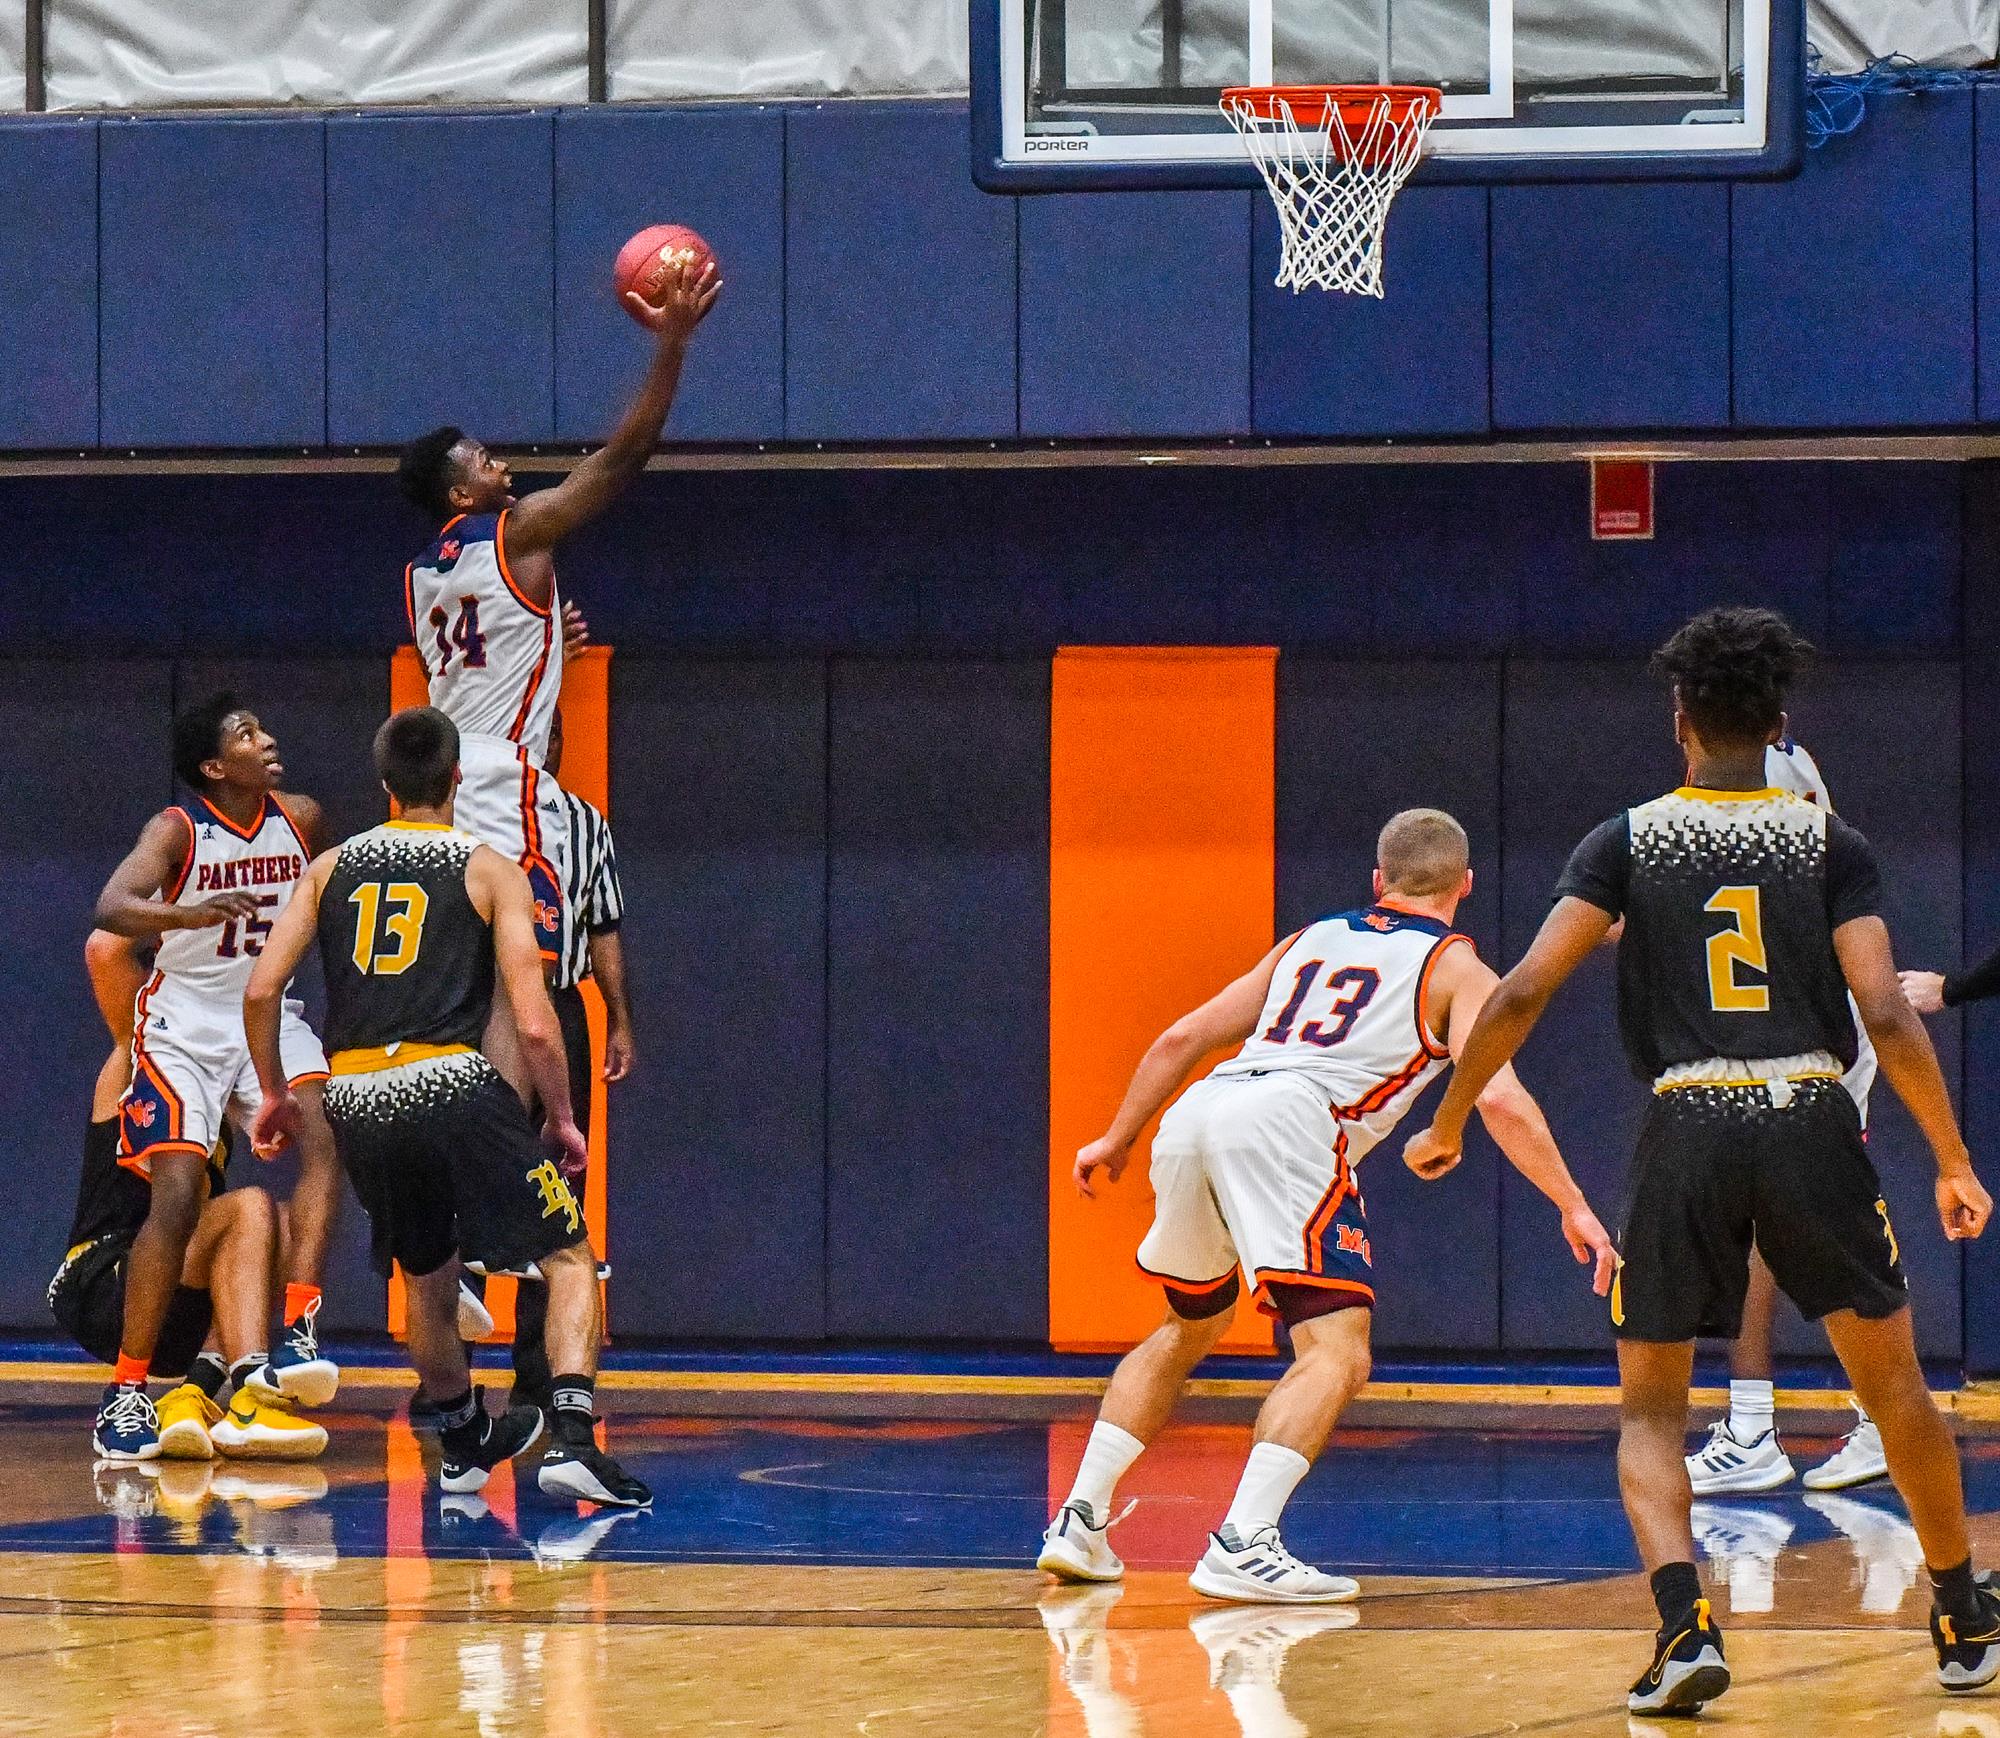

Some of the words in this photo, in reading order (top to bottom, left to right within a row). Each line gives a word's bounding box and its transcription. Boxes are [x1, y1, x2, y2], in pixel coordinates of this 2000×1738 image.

[429, 594, 487, 677] 14
[196, 854, 302, 891] PANTHERS
[216, 894, 278, 958] 15
[348, 882, 429, 975] 13
[1704, 885, 1770, 1011] 2
[1262, 958, 1382, 1048] 13
